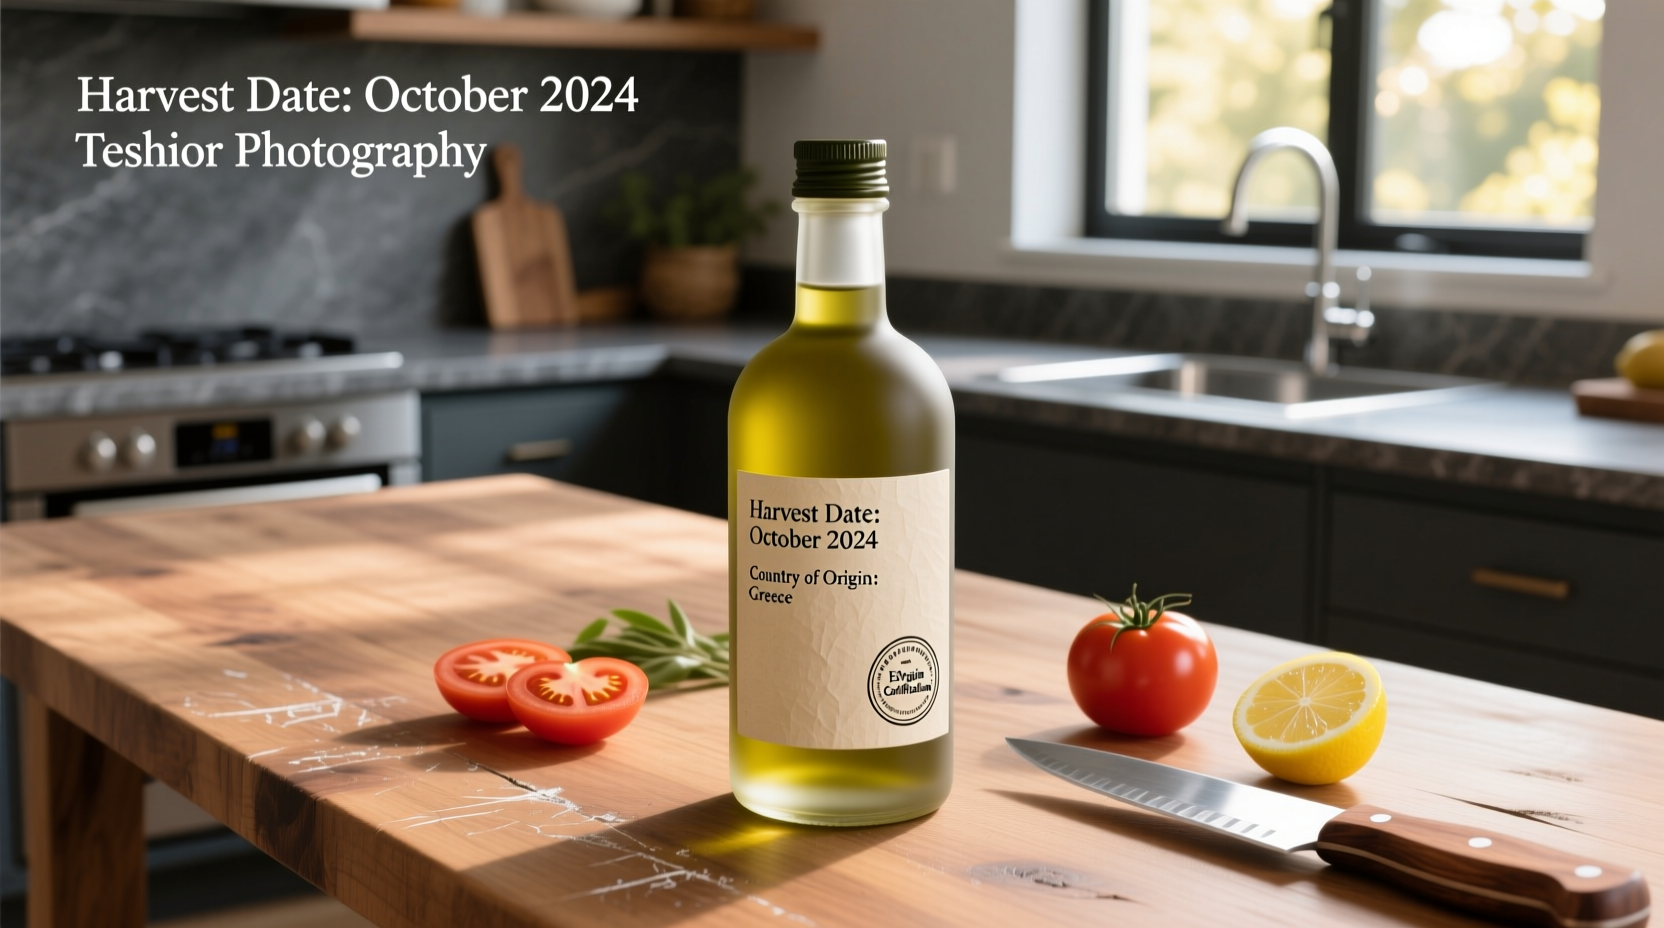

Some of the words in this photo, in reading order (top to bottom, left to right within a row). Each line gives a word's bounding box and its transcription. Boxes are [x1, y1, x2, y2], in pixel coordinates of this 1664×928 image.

[749, 498, 819, 523] Harvest
[825, 503, 880, 524] Date:
[749, 525, 822, 549] October
[826, 530, 879, 550] 2024
[749, 565, 800, 589] Country
[804, 569, 821, 585] of
[823, 569, 879, 590] Origin:
[748, 585, 793, 605] Greece
